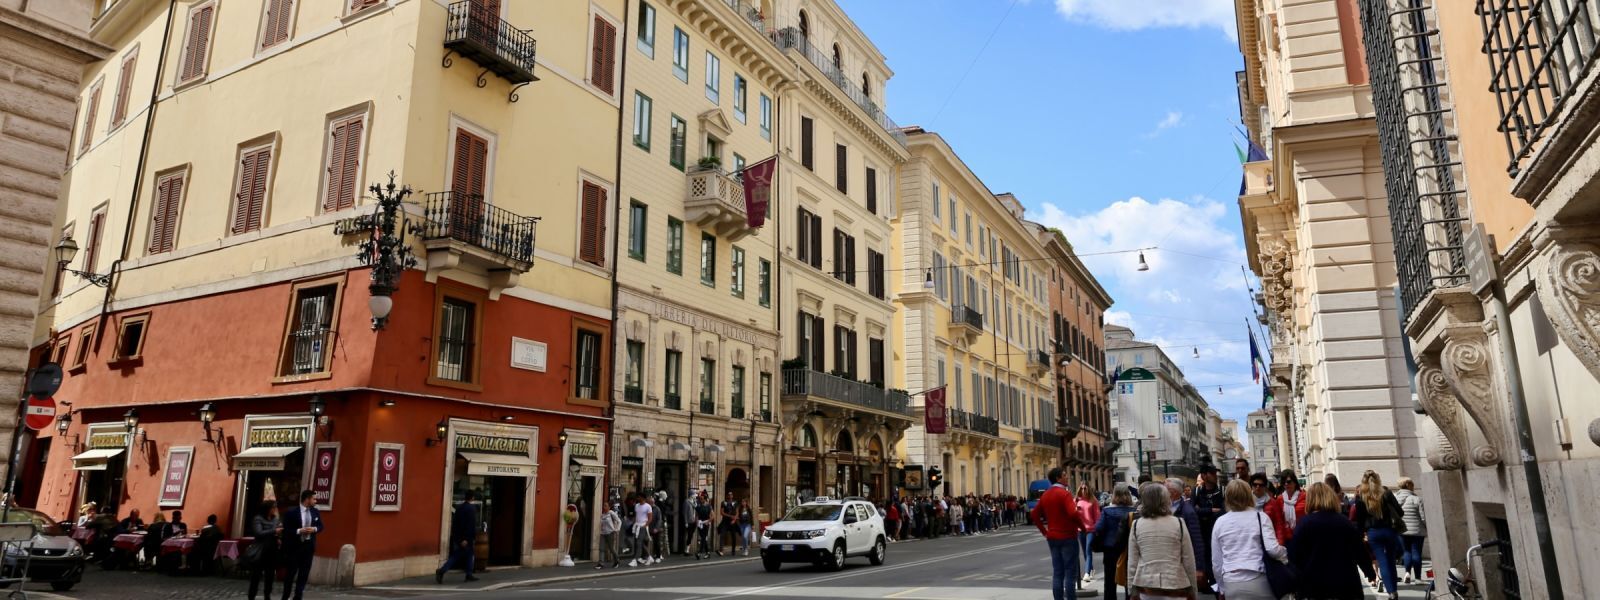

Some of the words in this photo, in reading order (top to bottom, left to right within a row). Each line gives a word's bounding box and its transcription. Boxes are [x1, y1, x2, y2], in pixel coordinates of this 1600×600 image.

[654, 303, 697, 327] LIBRERIA
[251, 429, 307, 443] BIRRERIA
[487, 465, 520, 474] RISTORANTE
[385, 473, 391, 481] IL
[378, 483, 397, 492] GALLO
[379, 493, 396, 502] NERO
